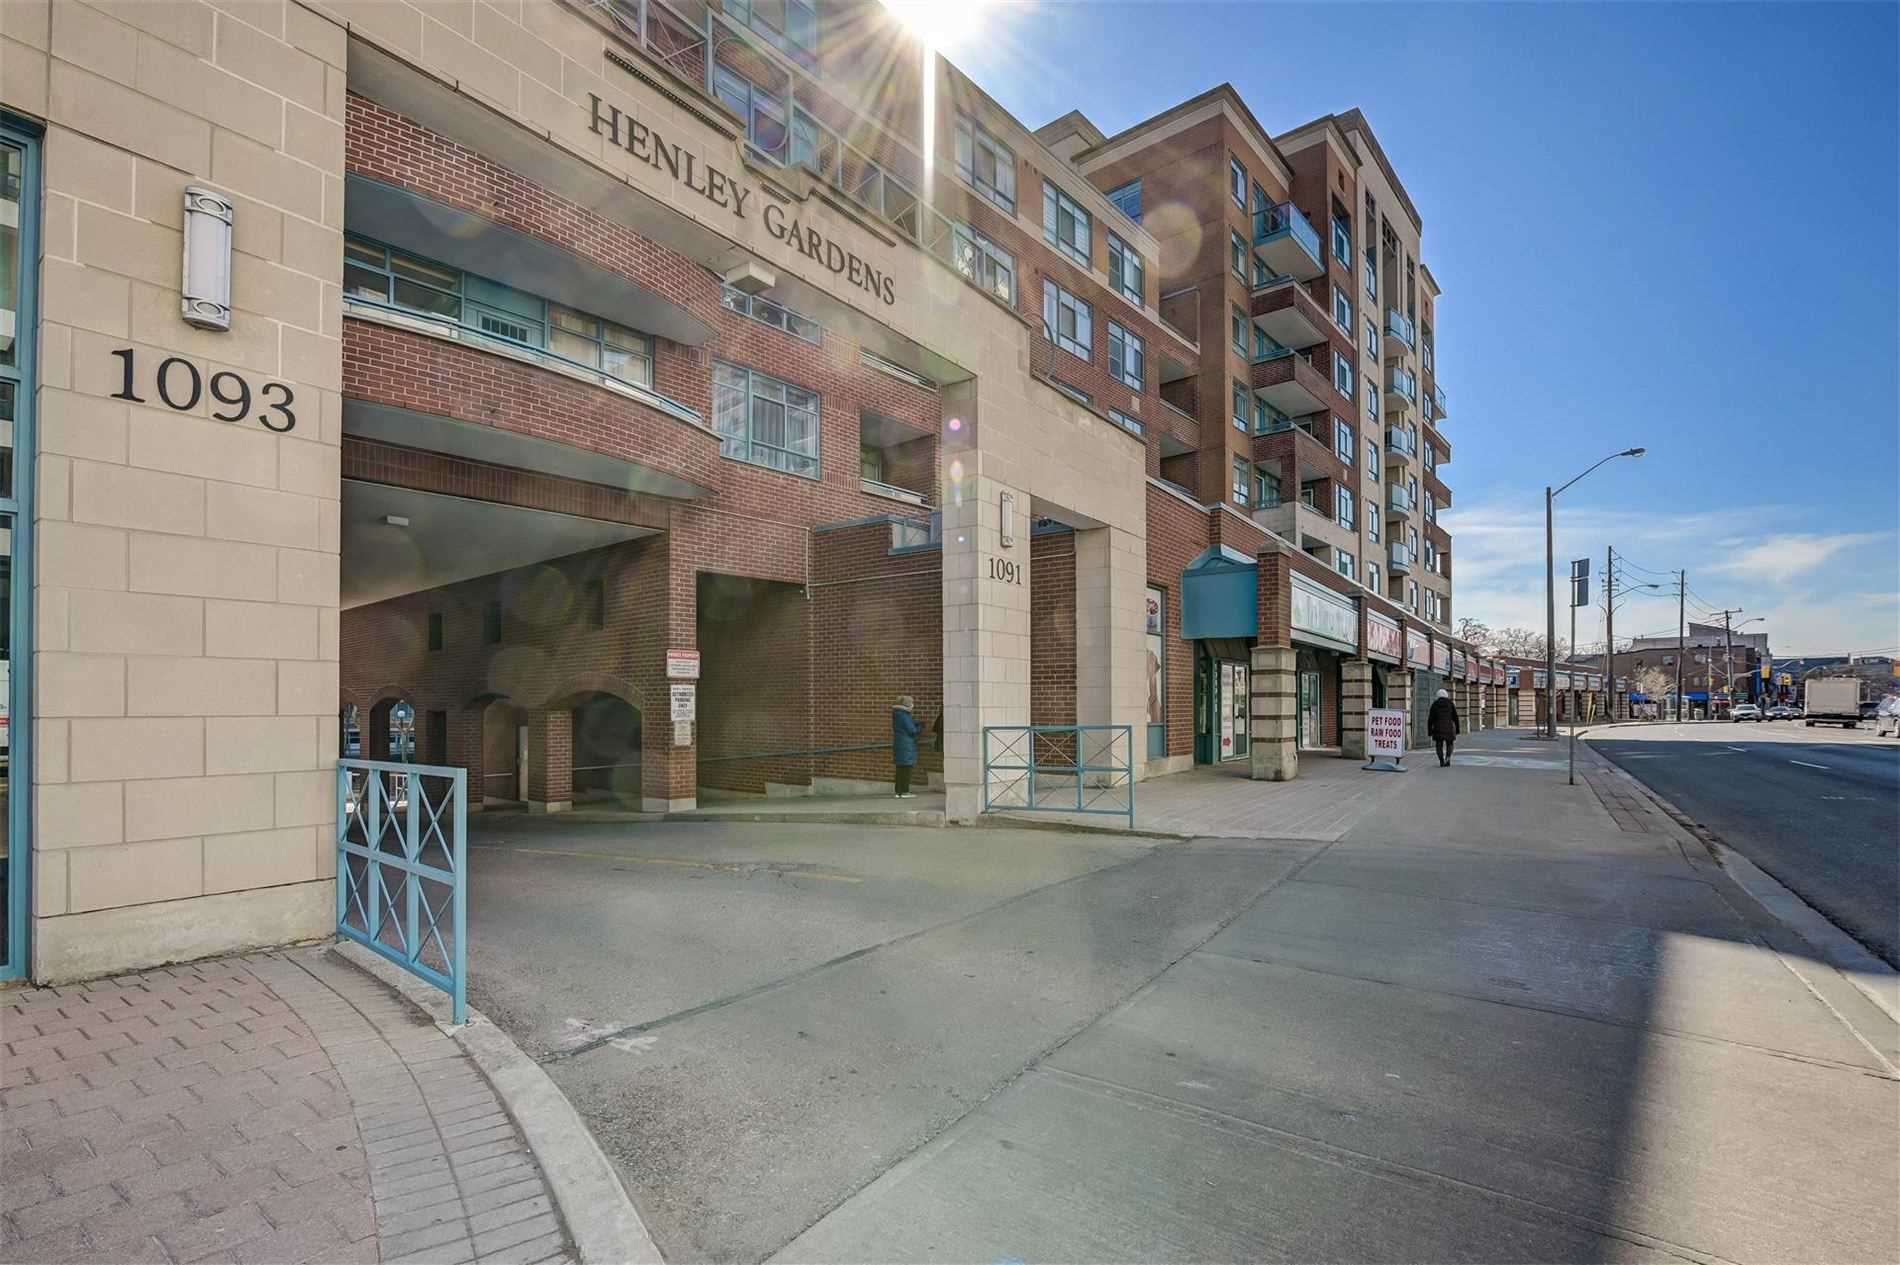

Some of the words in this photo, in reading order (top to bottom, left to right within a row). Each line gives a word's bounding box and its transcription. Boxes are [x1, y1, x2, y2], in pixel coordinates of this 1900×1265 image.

[588, 92, 750, 219] HENLEY
[763, 204, 895, 305] GARDENS
[110, 348, 296, 432] 1093
[989, 557, 1021, 585] 1091
[1371, 716, 1383, 726] PET
[1385, 716, 1402, 727] FOOD
[1371, 728, 1384, 737] RAW
[1385, 728, 1402, 738] FOOD
[1375, 739, 1398, 749] TREATS
